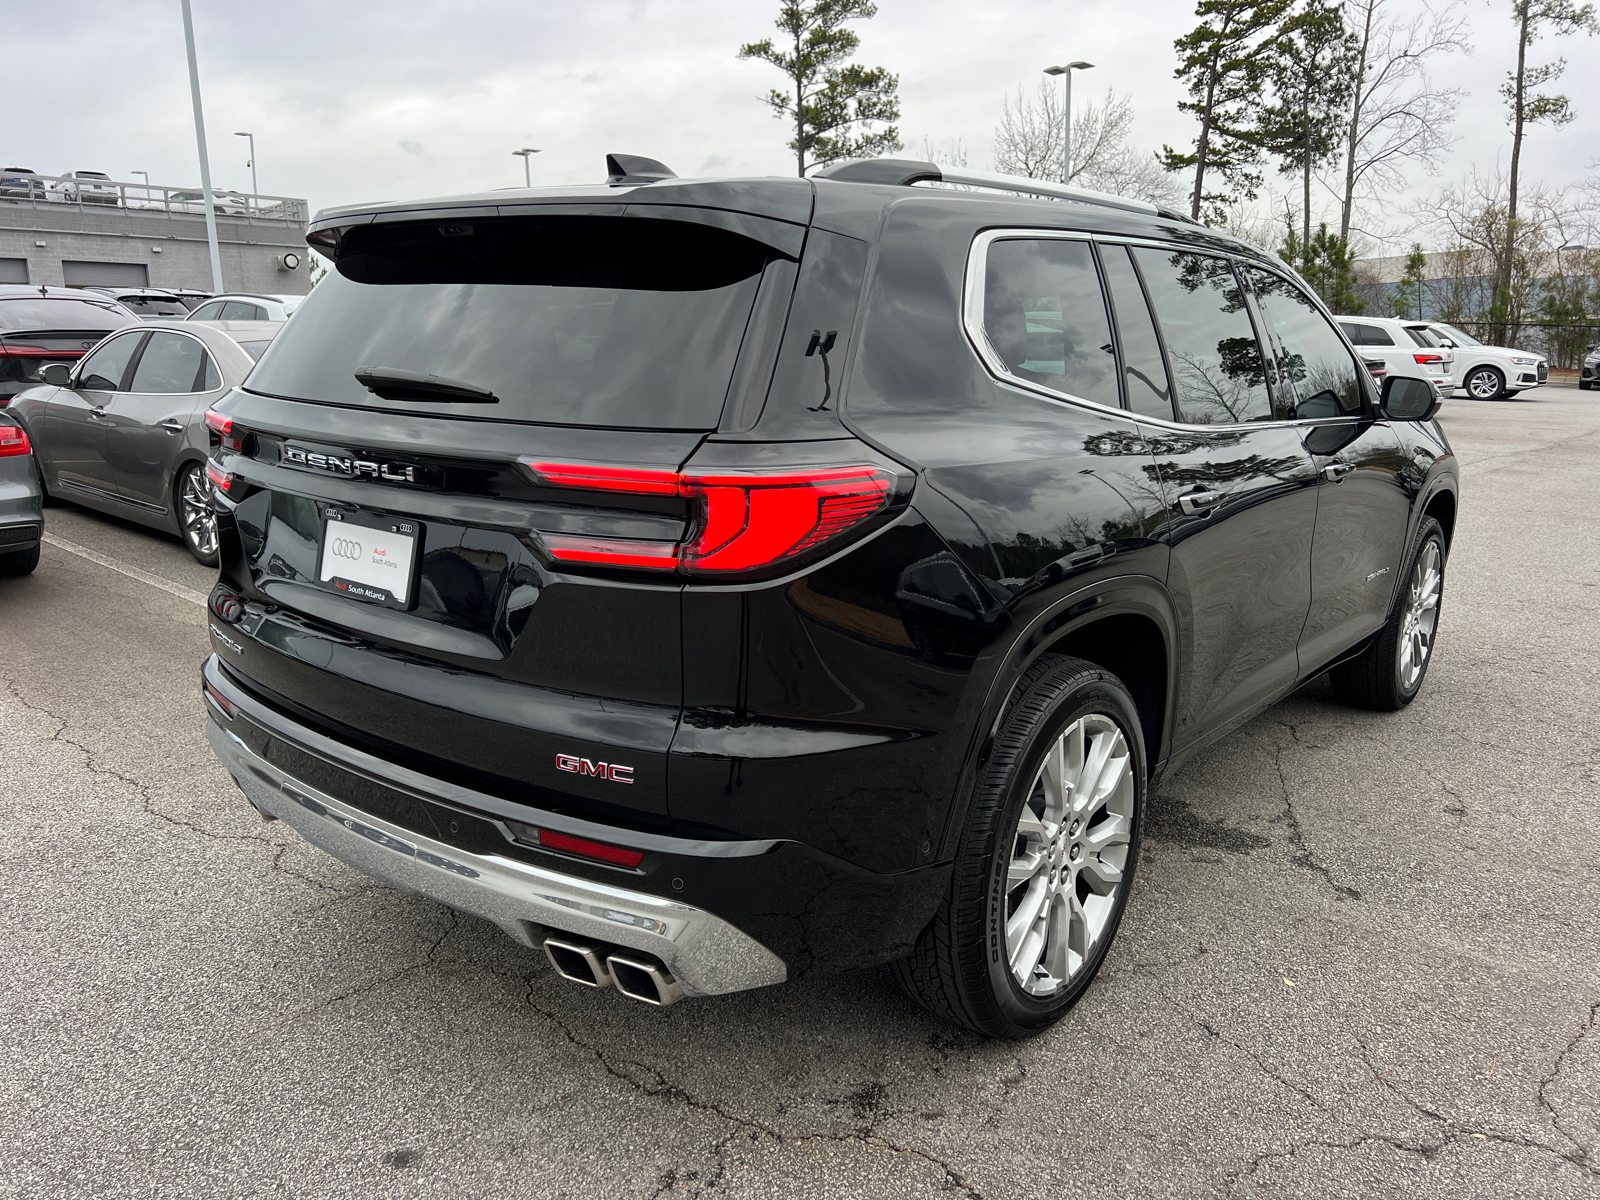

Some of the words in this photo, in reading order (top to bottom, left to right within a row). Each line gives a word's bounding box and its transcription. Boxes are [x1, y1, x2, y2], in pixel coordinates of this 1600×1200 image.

[285, 446, 414, 482] DENALI
[373, 547, 387, 557] Audi
[371, 556, 384, 566] South
[384, 559, 398, 569] Atlanta
[335, 581, 348, 590] Audi
[348, 584, 364, 595] South
[364, 589, 386, 601] Atlanta
[556, 753, 634, 784] GMC
